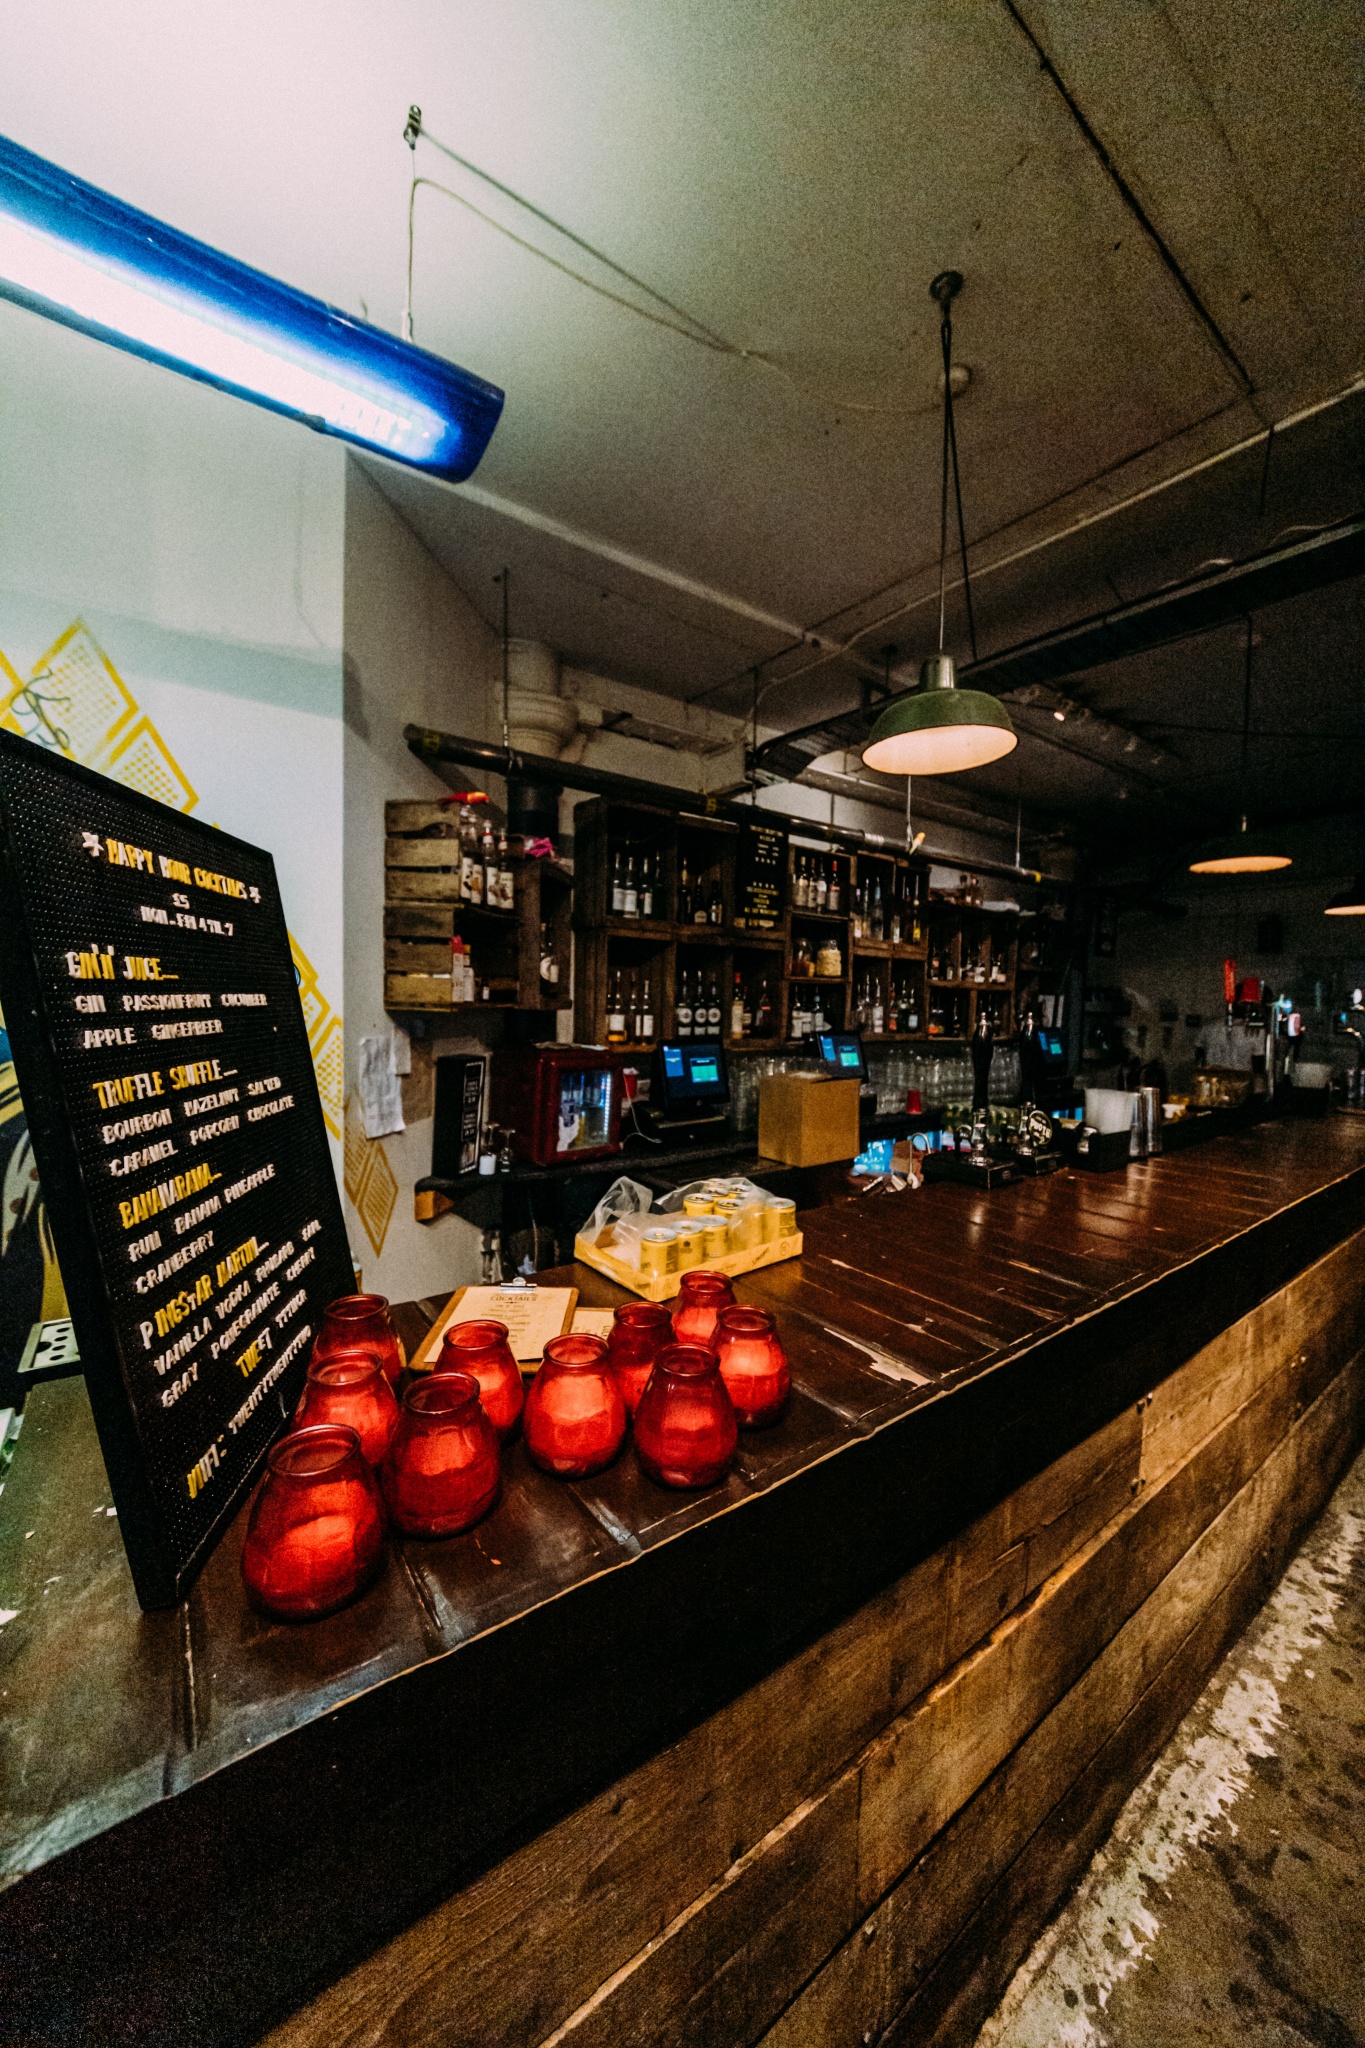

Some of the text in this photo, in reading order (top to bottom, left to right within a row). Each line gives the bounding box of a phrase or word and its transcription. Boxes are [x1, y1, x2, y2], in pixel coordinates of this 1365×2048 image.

[105, 838, 154, 874] HAPPY
[158, 855, 192, 885] HOUR
[74, 994, 107, 1013] GIN
[83, 1027, 137, 1049] APPLE
[92, 1071, 165, 1110] TRUFFLE
[102, 1076, 282, 1145] BOURBON HAZELNUT SALTED
[108, 1139, 179, 1177] CARAMEL
[246, 1094, 296, 1123] CHOCOLATE
[127, 1163, 276, 1262] RUM BANANA PINEAPPLE
[135, 1230, 215, 1294] CRANBERRY
[153, 1316, 213, 1376] VANILLA
[215, 1280, 252, 1320] VODKA
[161, 1246, 316, 1408] GRAY POMEGRANATE CHERRY
[235, 1327, 273, 1378] TWEET
